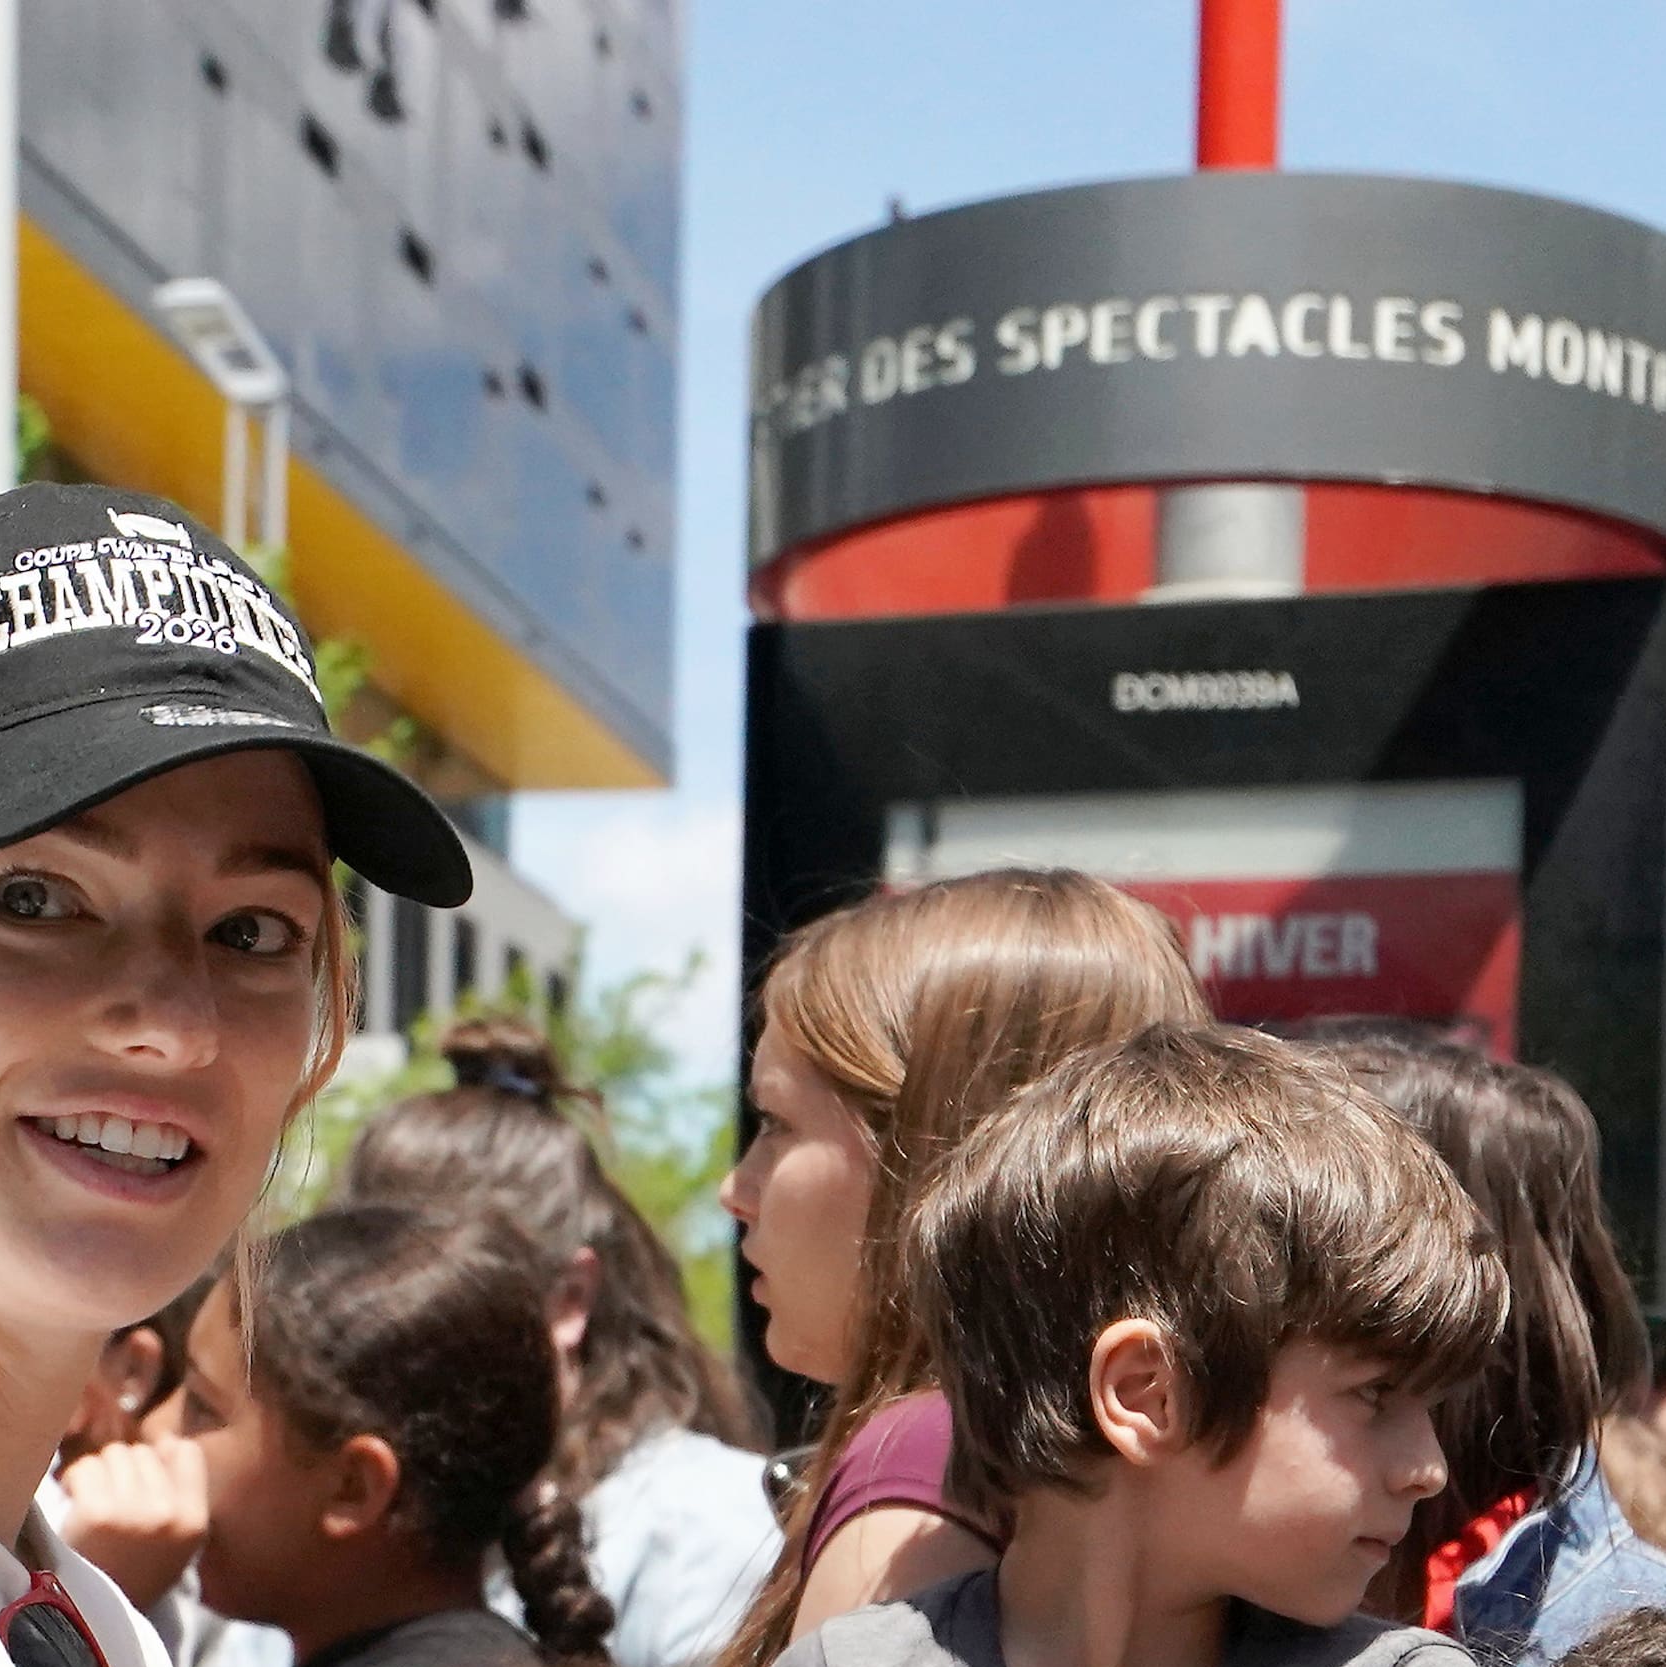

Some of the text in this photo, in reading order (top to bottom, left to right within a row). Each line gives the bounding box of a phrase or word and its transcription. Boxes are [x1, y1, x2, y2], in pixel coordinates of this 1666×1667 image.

[859, 317, 977, 407] DES
[993, 288, 1468, 373] SPECTACLES
[14, 537, 196, 572] COUPE WALTER
[135, 613, 239, 656] 2026
[1190, 911, 1381, 980] HIVER
